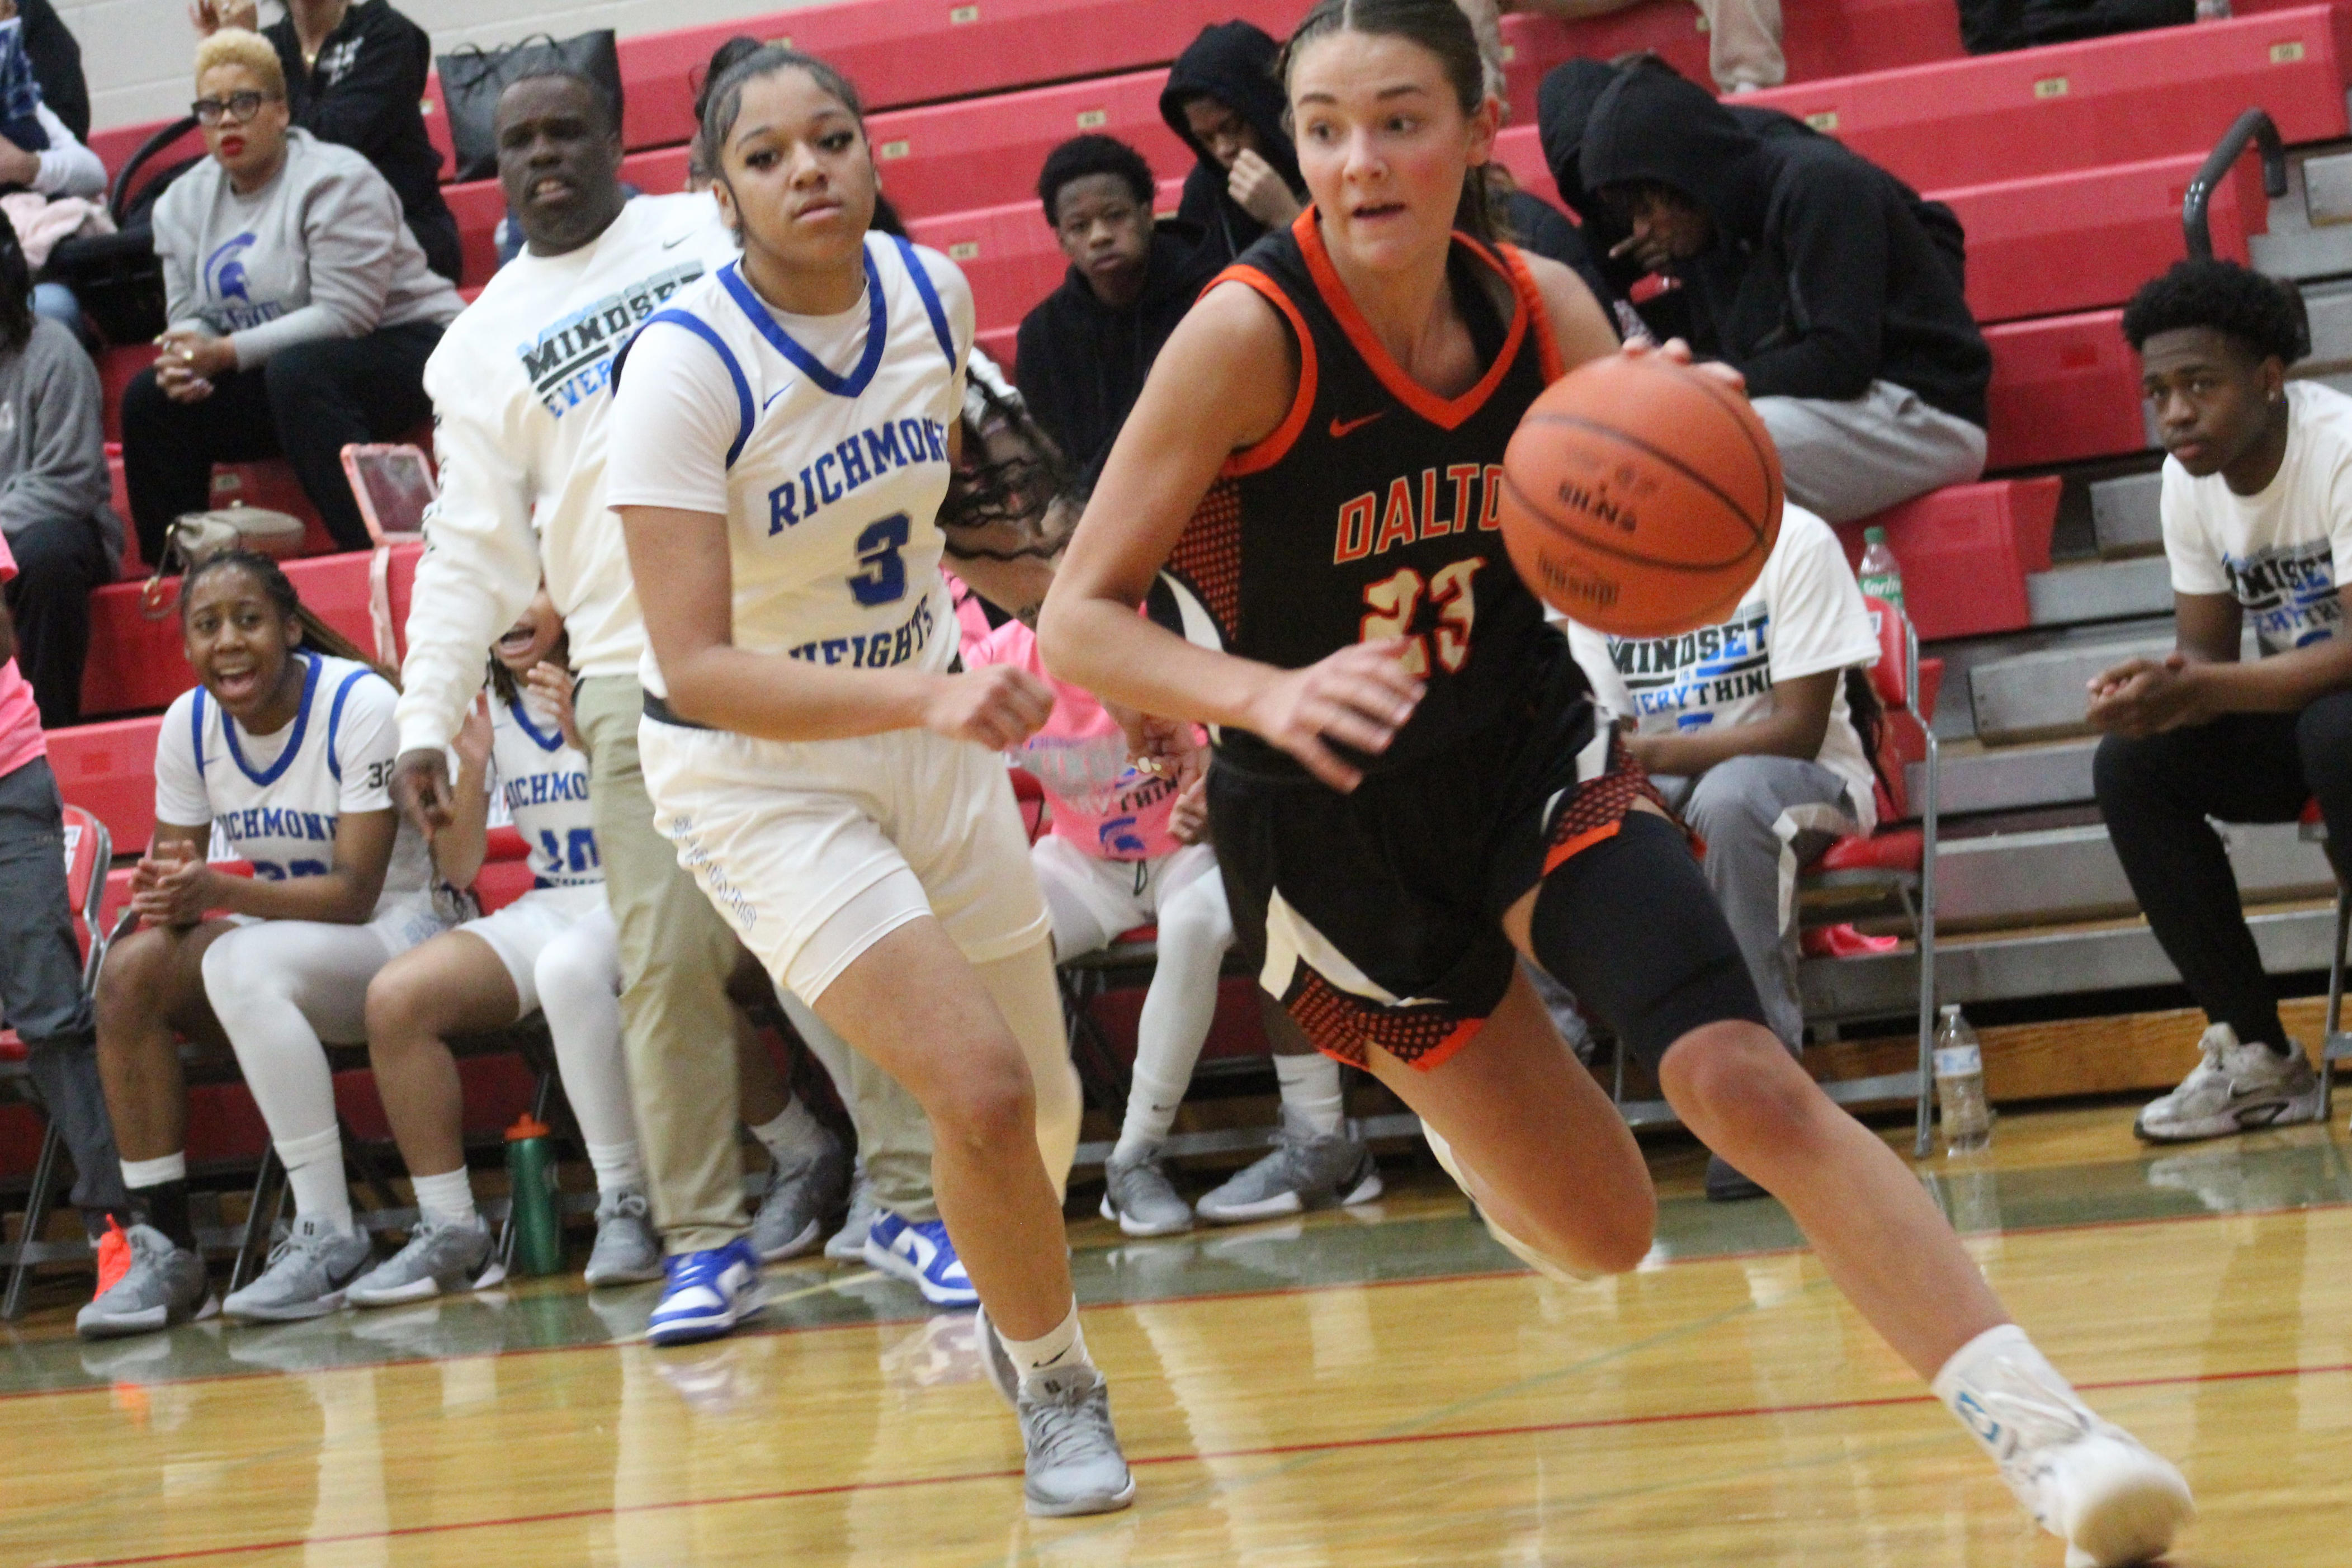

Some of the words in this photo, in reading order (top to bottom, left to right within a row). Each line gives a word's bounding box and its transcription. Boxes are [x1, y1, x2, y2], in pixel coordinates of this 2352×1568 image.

[847, 509, 913, 609] 3
[1359, 556, 1487, 679] 23
[1606, 615, 1769, 674] MINDSET
[368, 758, 395, 790] 32
